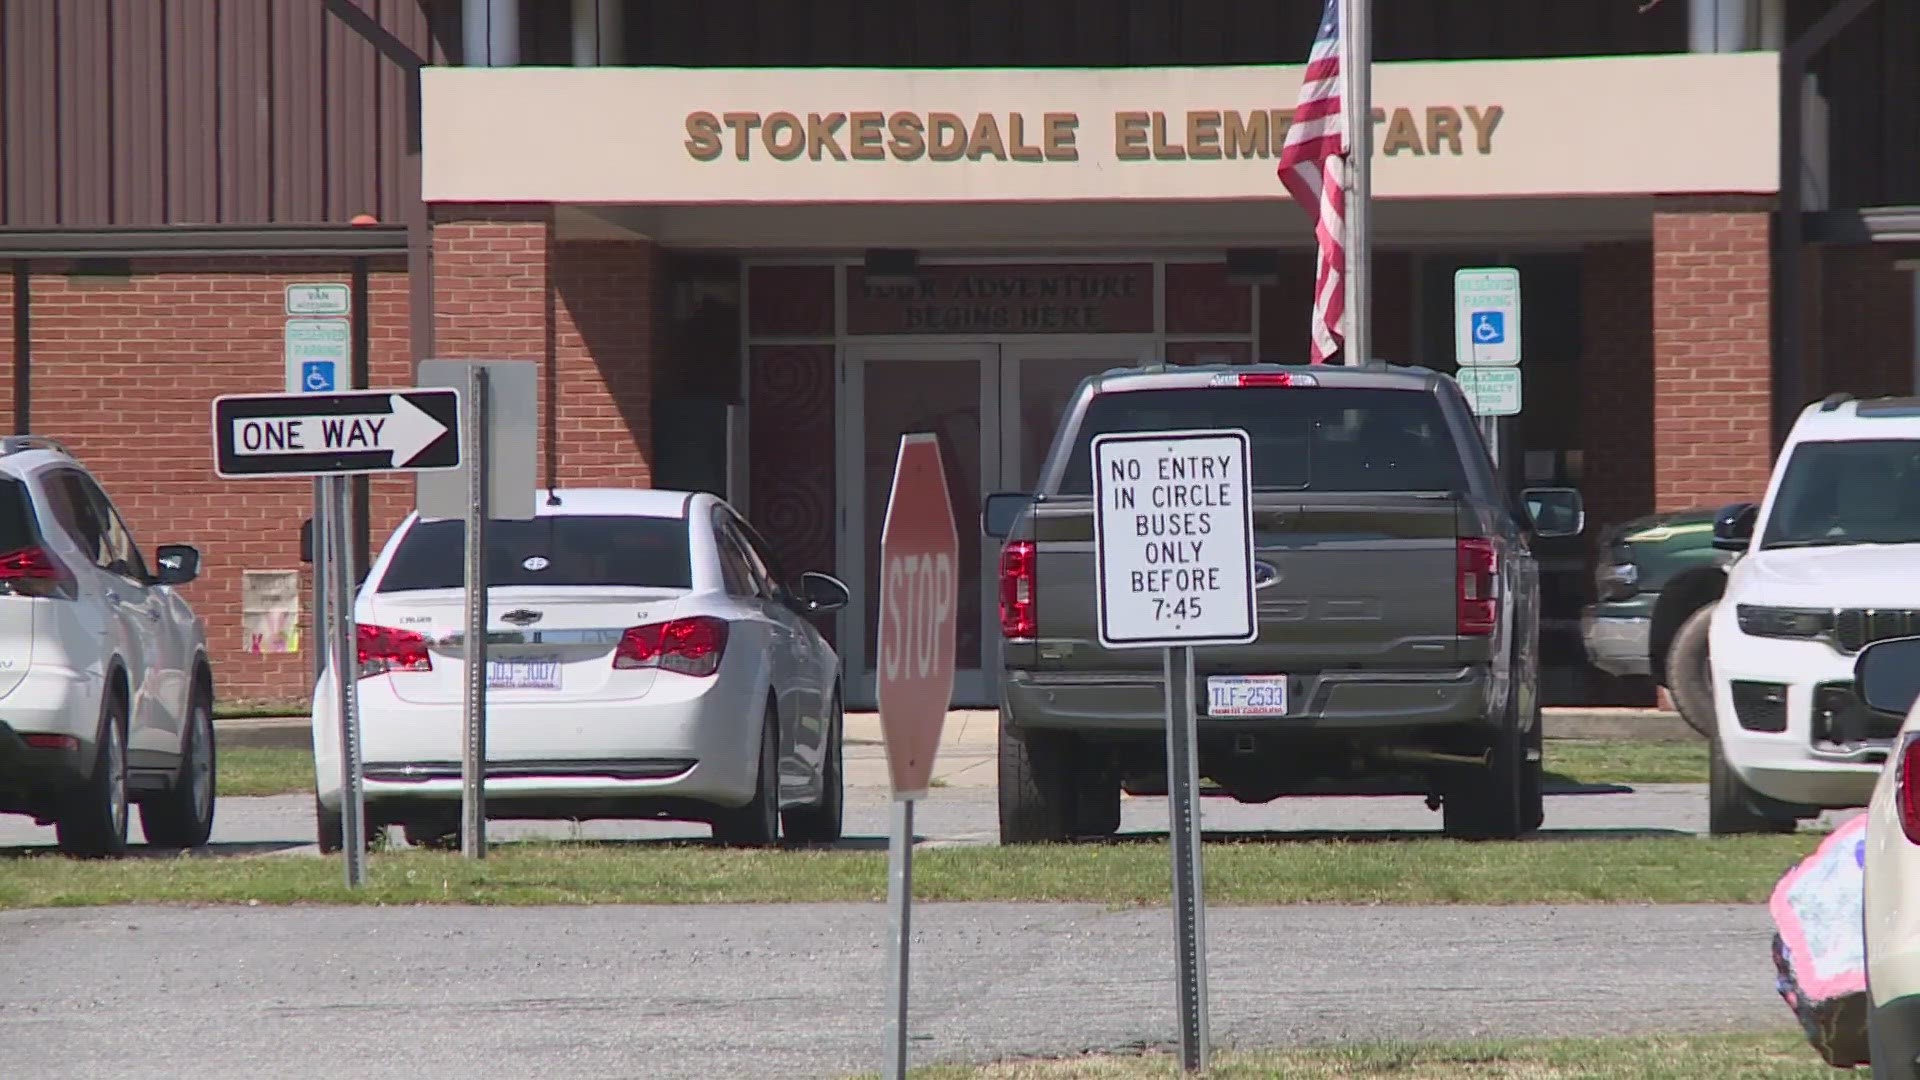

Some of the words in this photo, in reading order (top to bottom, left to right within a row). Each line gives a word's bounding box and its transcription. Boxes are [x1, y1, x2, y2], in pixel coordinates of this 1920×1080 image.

[684, 111, 1079, 162] STOKESDALE
[1115, 105, 1503, 160] ELEMEARY
[952, 272, 1137, 298] ADVENTURE
[243, 421, 304, 451] ONE
[322, 417, 386, 448] WAY
[1111, 459, 1141, 481] NO
[1158, 456, 1231, 481] ENTRY
[1114, 486, 1135, 509] IN
[1152, 484, 1232, 508] CIRCLE
[1136, 513, 1211, 536] BUSES
[1145, 540, 1204, 564] ONLY
[1131, 567, 1221, 592] BEFORE
[886, 552, 950, 682] STOP
[1152, 597, 1202, 620] 7:45
[1212, 687, 1283, 707] TLF-2533
